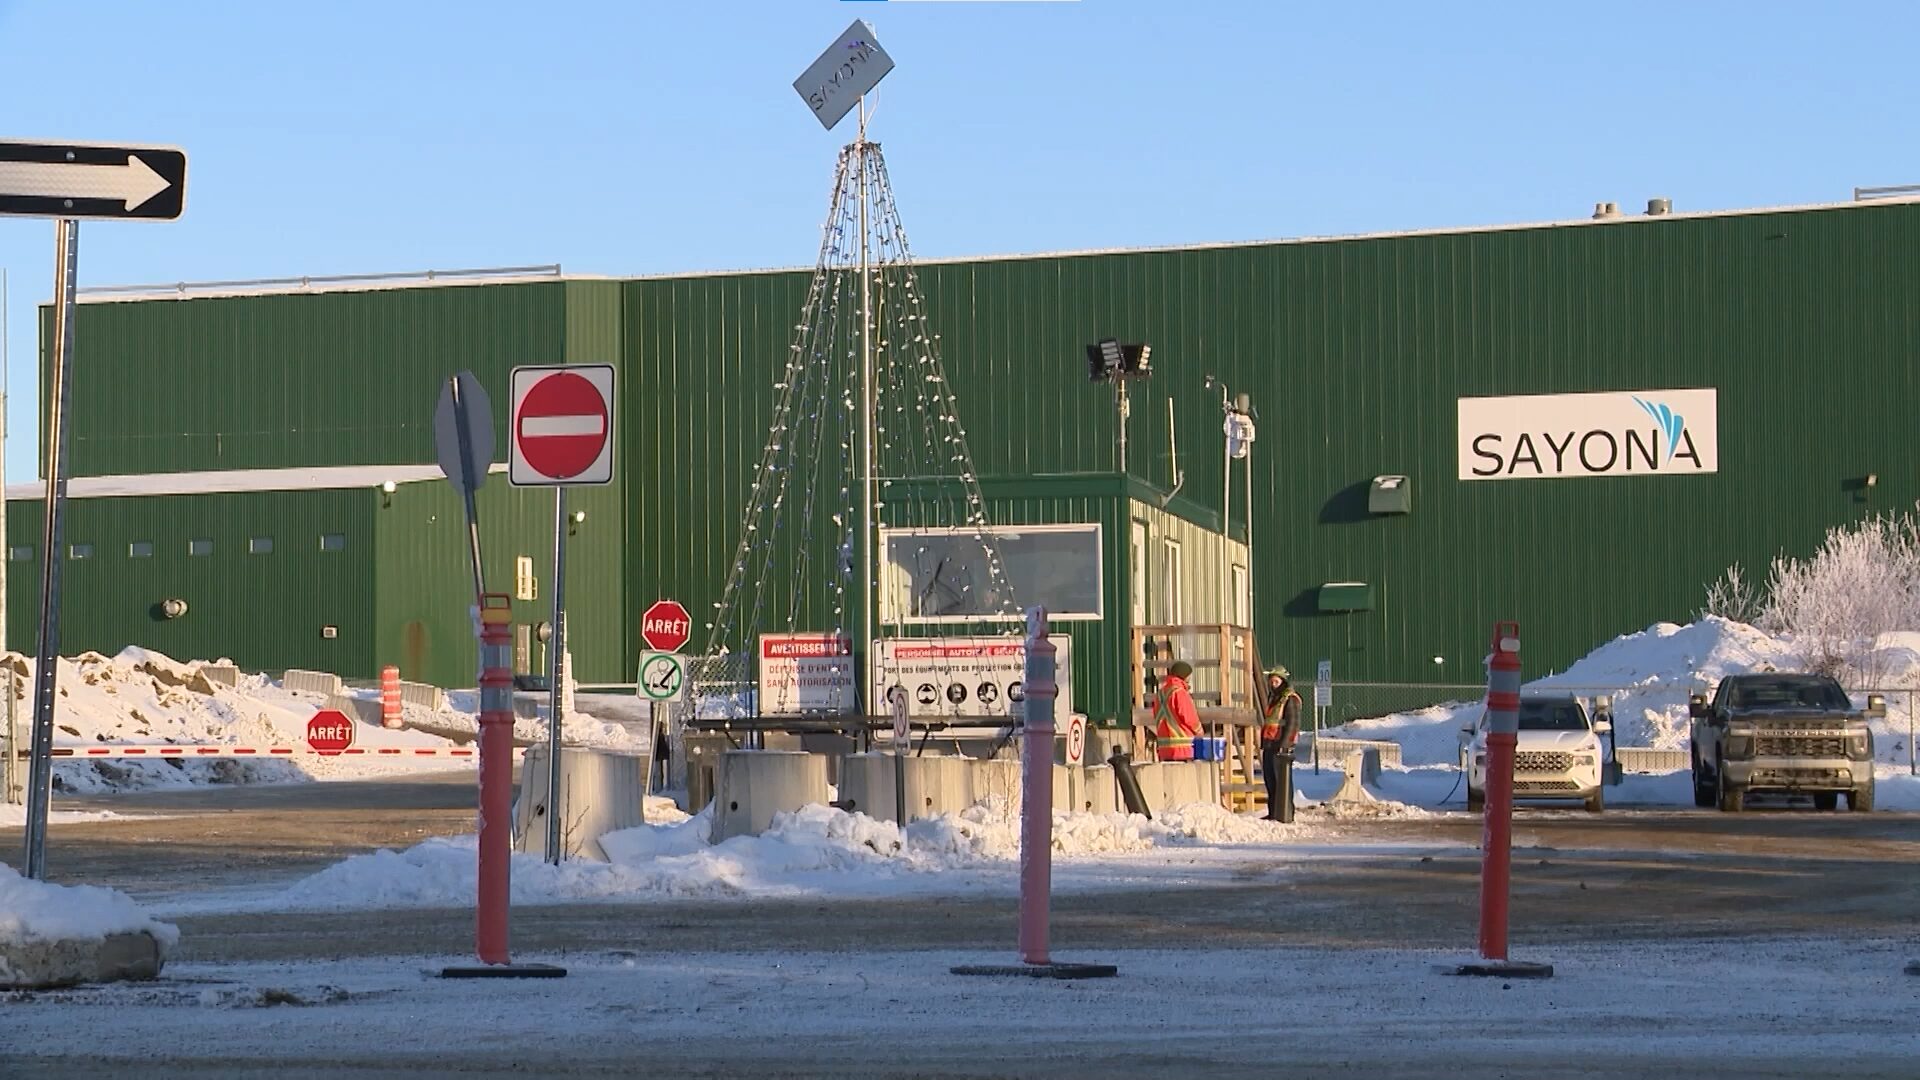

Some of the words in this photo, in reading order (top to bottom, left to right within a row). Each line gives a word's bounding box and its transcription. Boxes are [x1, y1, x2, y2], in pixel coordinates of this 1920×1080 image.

[809, 40, 878, 111] SAYONA
[1471, 428, 1702, 477] SAYONA
[646, 618, 688, 636] ARRÊT
[770, 643, 849, 654] AVERTISSEM
[808, 663, 849, 674] D'ENTR
[791, 677, 851, 687] AUTORISAON
[309, 723, 351, 740] ARRÊT
